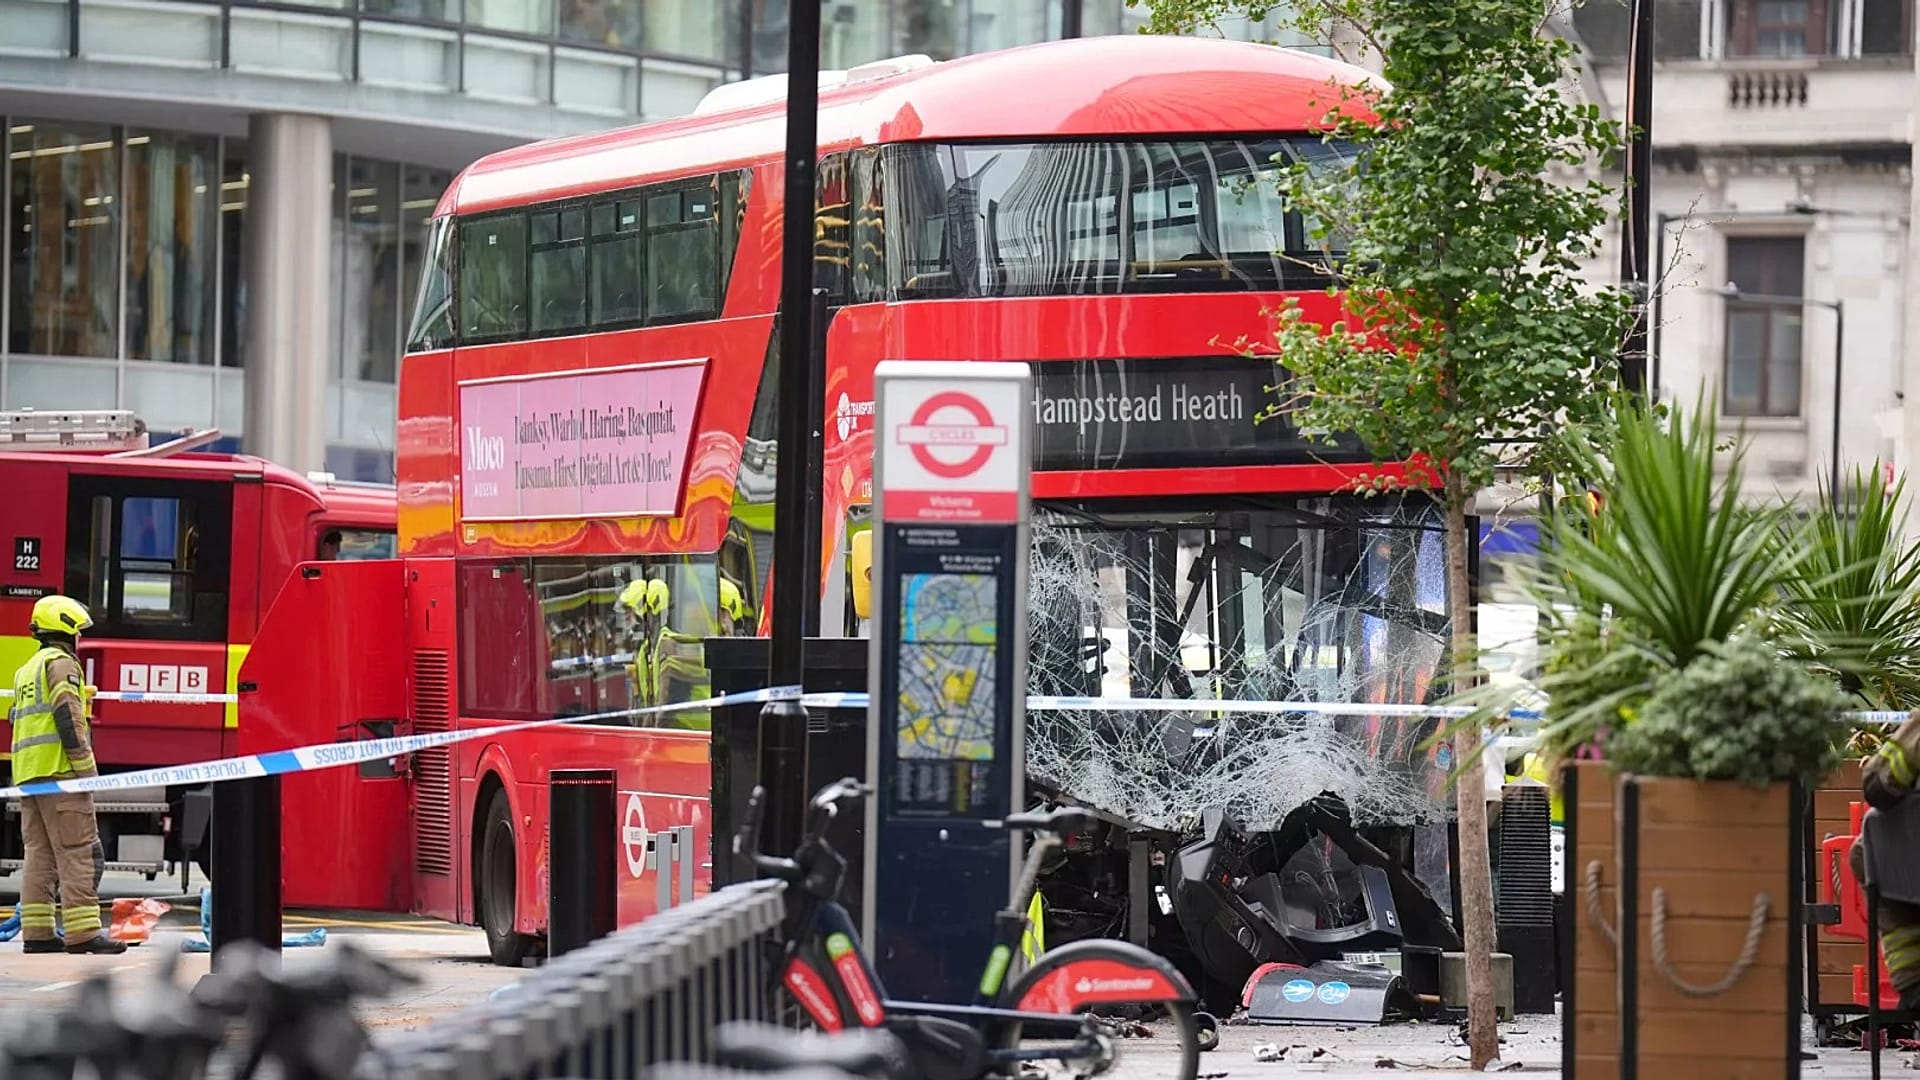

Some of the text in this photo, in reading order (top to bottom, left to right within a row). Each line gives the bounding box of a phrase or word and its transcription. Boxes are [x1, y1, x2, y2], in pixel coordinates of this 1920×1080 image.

[1172, 382, 1243, 421] Heath
[466, 425, 504, 471] Moco
[23, 540, 33, 554] H
[15, 555, 39, 569] 222
[8, 588, 43, 596] LAMBETH
[314, 746, 355, 765] CROSS
[172, 766, 201, 780] LINE
[205, 760, 247, 778] POLICE
[151, 770, 170, 783] DO
